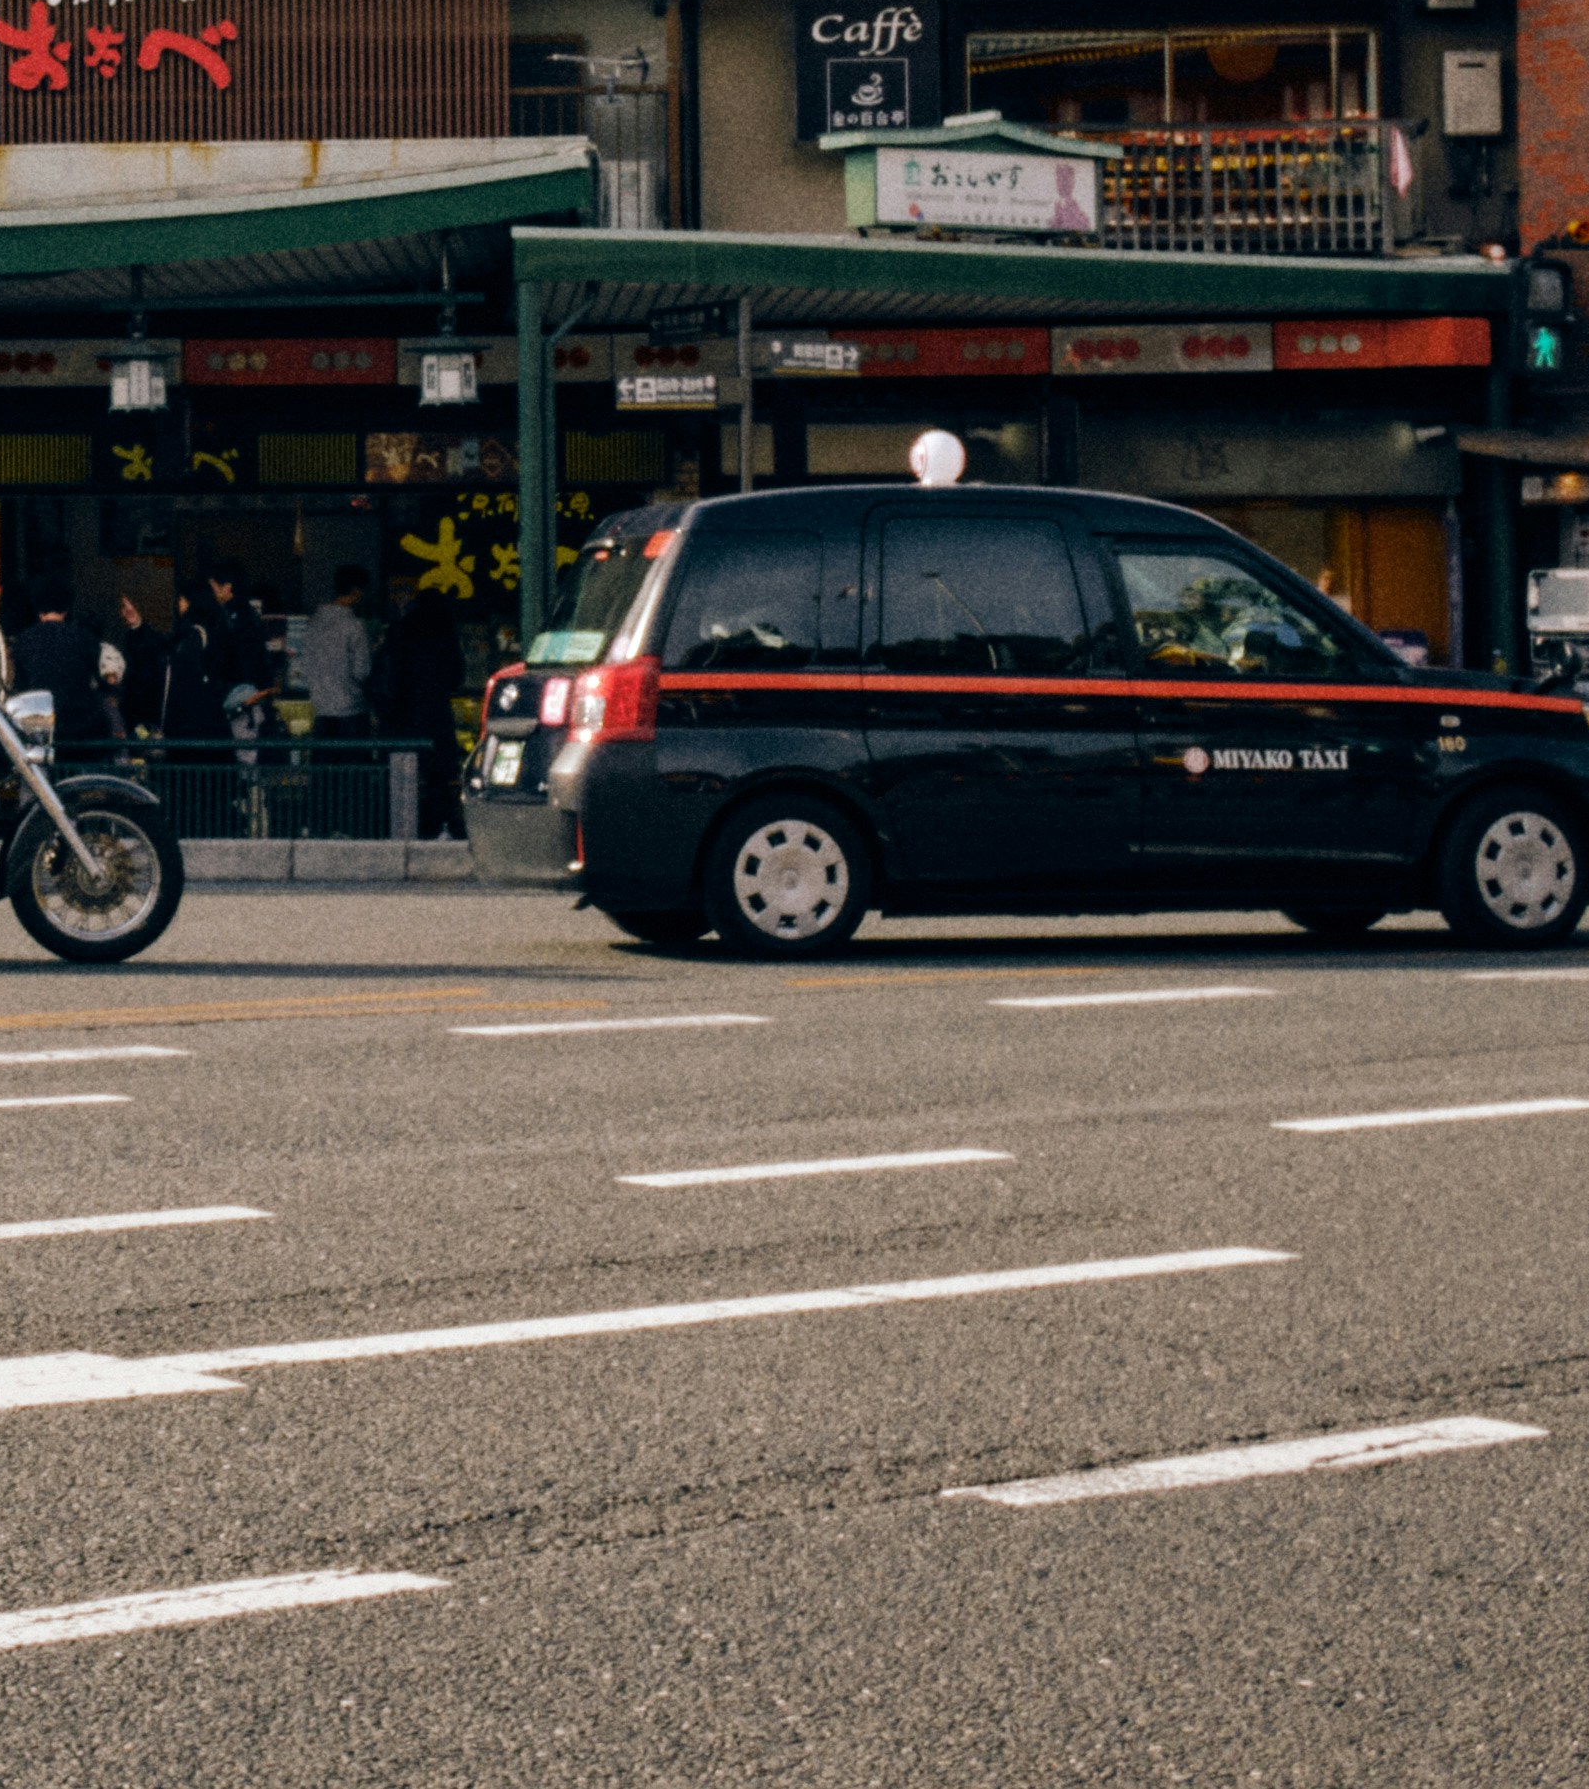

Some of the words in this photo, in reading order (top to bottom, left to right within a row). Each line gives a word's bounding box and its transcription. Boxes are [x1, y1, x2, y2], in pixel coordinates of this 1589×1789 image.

[811, 7, 923, 57] Caffè
[457, 491, 595, 522] 京都菓
[1213, 749, 1294, 770] MIYAKO
